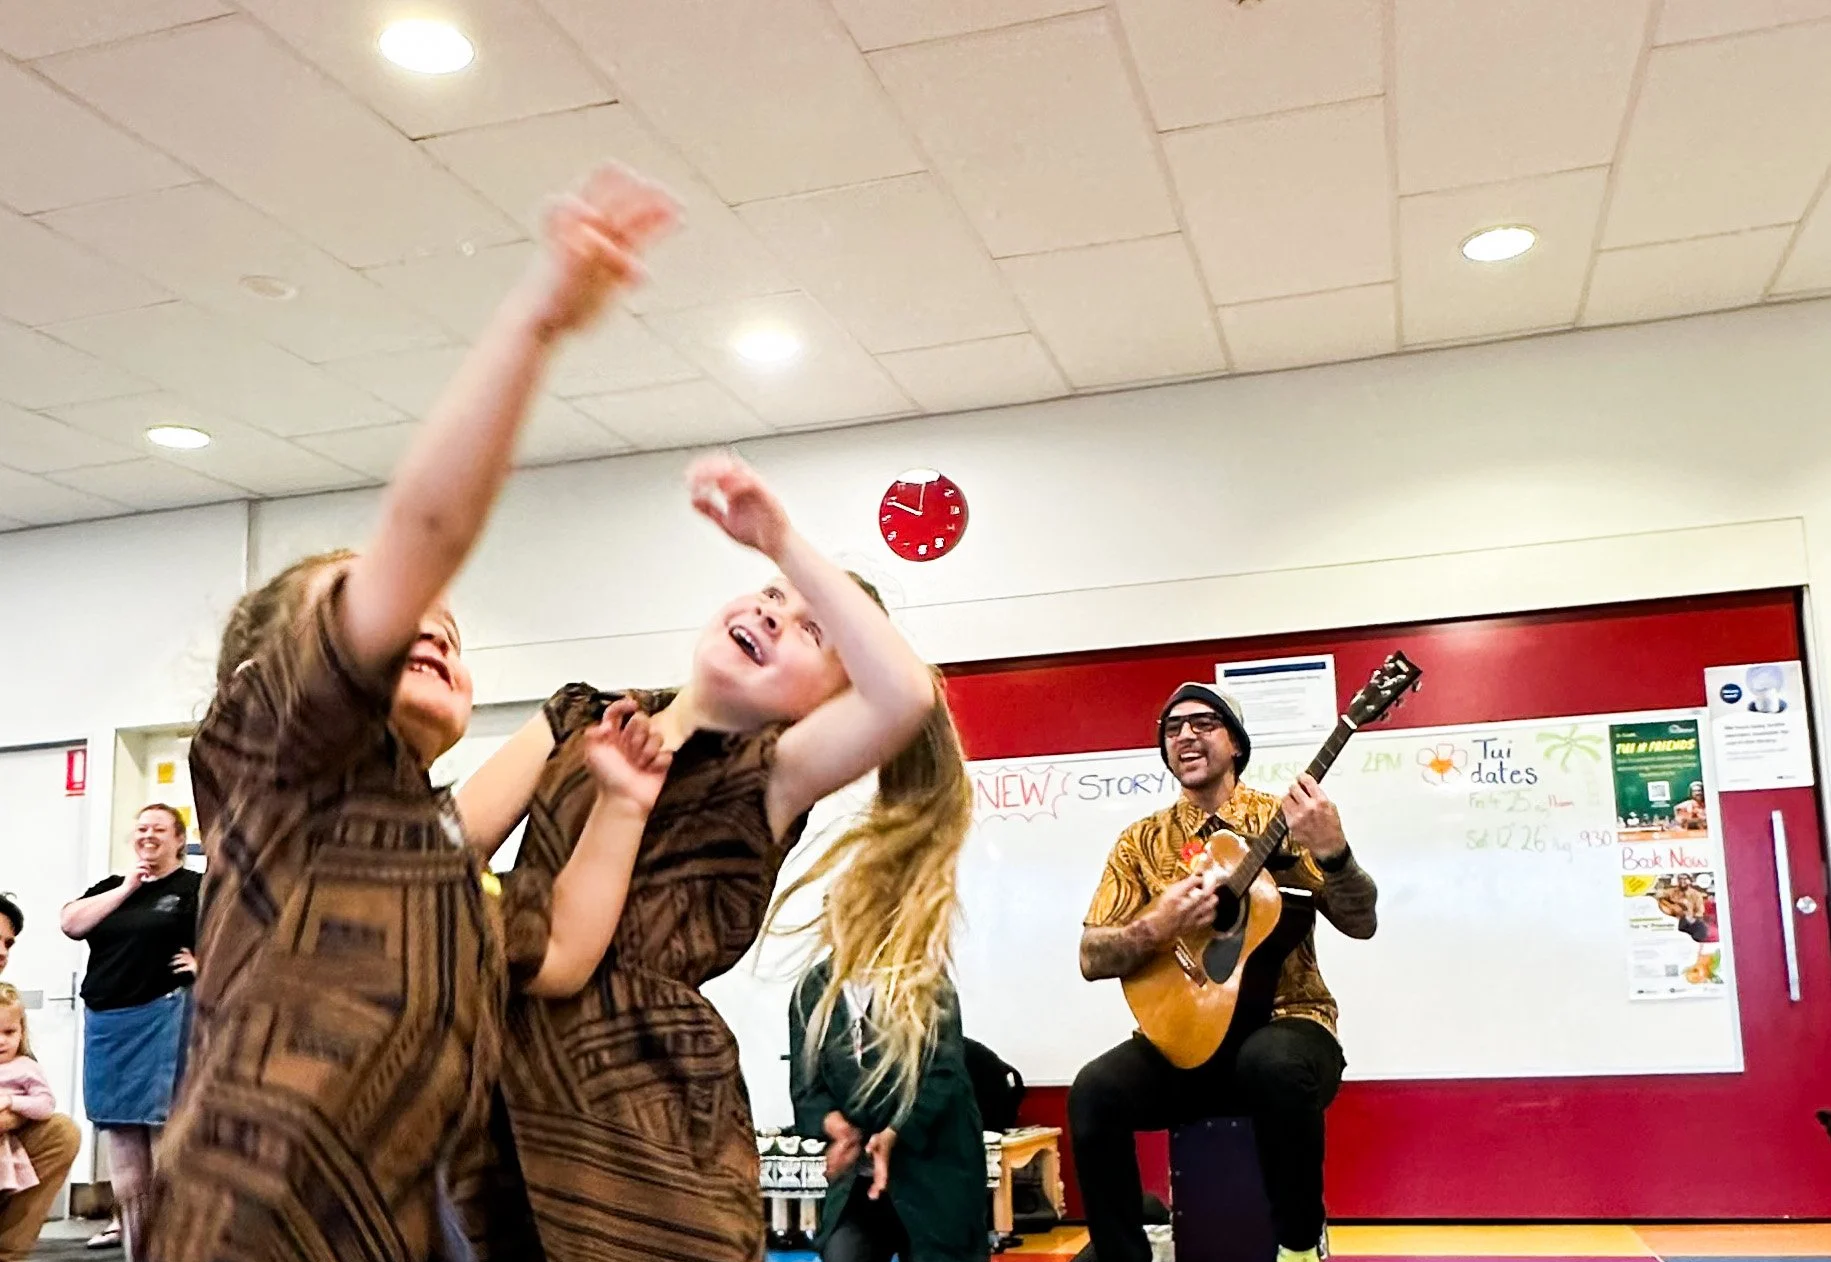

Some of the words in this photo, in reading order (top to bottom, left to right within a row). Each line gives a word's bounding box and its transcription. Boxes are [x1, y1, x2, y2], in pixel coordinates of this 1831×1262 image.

[1472, 737, 1511, 760] Tui
[1470, 760, 1538, 785] dates
[977, 772, 1051, 810] NEW
[1622, 846, 1664, 871] Book
[1669, 846, 1710, 869] Now
